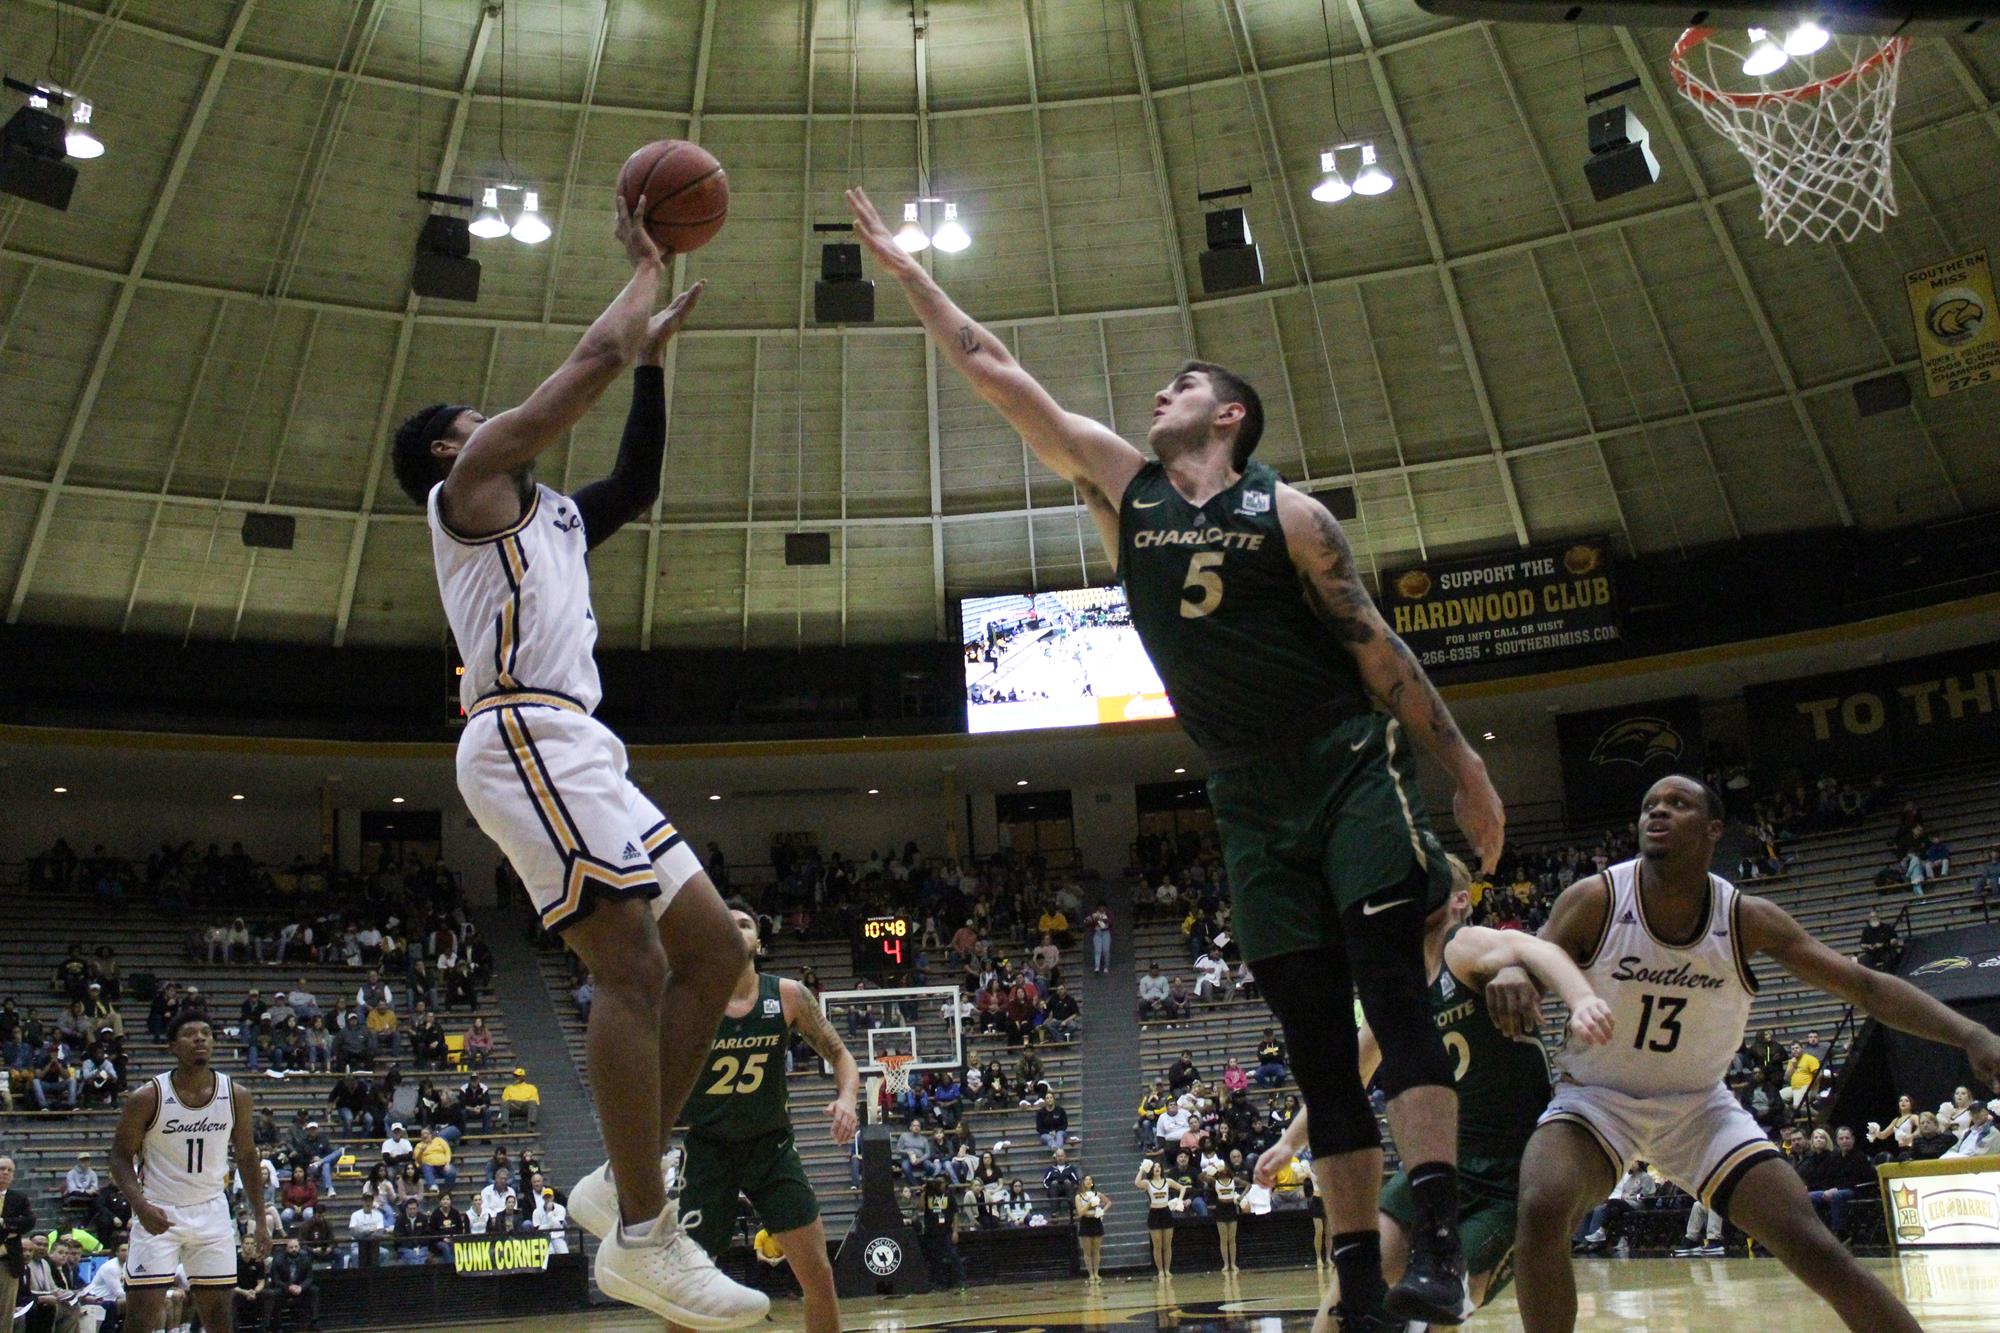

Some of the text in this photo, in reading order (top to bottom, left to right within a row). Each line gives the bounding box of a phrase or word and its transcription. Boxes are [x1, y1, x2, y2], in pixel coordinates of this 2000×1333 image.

[1908, 254, 1985, 284] SOUTHERN
[1930, 272, 1967, 289] MISS
[1948, 370, 1991, 391] 27-5
[1134, 527, 1265, 550] CHARLOTTE
[1180, 552, 1226, 619] 5
[1441, 558, 1555, 590] SUPPORT THE
[1393, 576, 1611, 634] HARDWOOD CLUB
[1418, 625, 1619, 666] -266-6355 SOUTHERNMISS.COM
[1446, 619, 1565, 646] FOR INFO CALL OR VISIT
[1797, 669, 2000, 741] TO TH
[864, 919, 906, 938] 10:48
[883, 939, 902, 964] 4
[1612, 956, 1724, 989] Southern
[1433, 999, 1475, 1027] OTTE
[1633, 994, 1688, 1053] 13
[705, 1053, 769, 1095] 25
[162, 1117, 227, 1134] Southern
[186, 1138, 204, 1173] 11
[454, 1238, 548, 1272] DUNK CORNER
[866, 1240, 899, 1255] HANCOCK
[868, 1258, 899, 1273] WHITNEY
